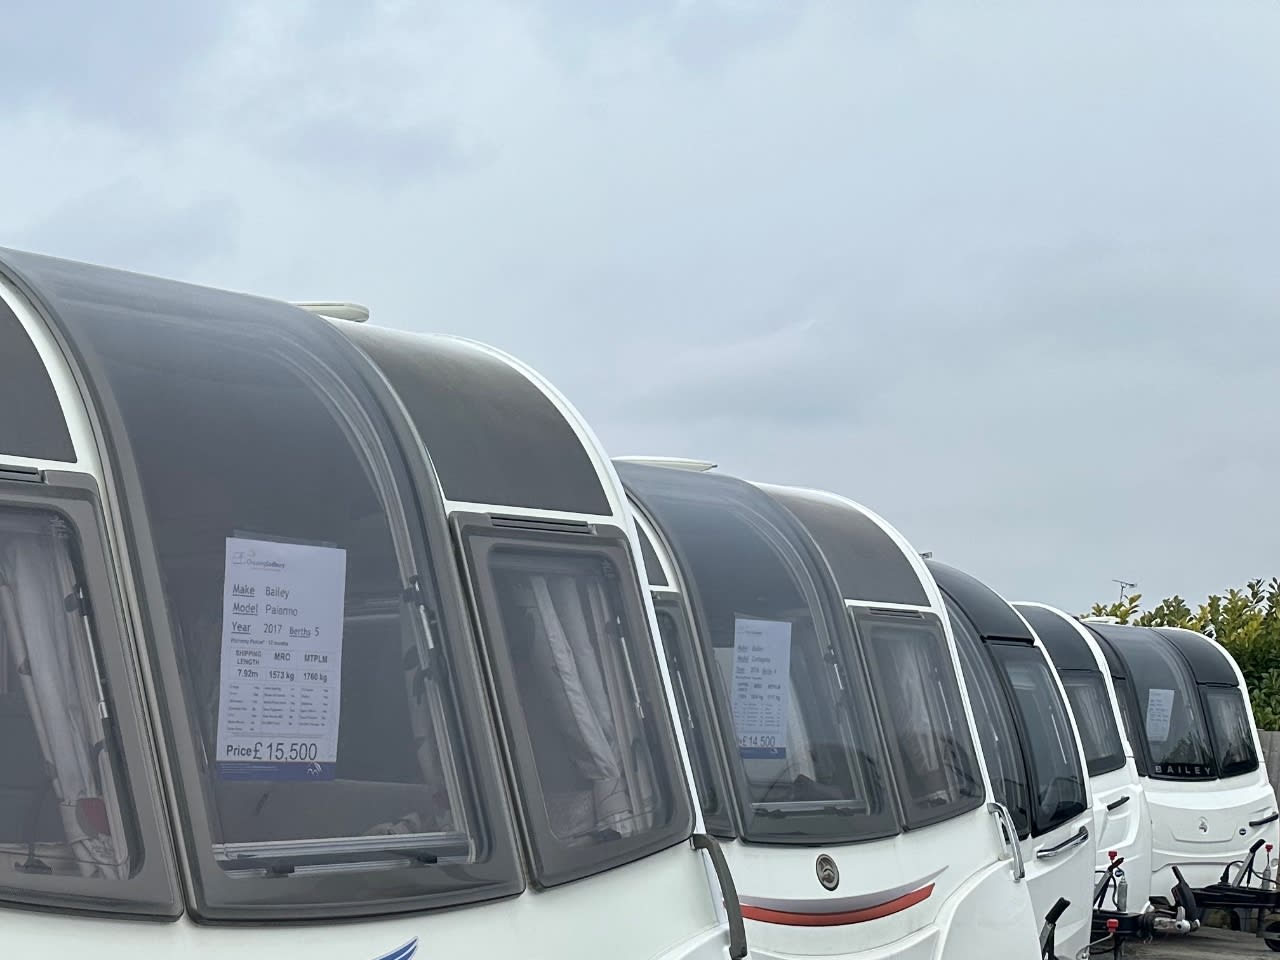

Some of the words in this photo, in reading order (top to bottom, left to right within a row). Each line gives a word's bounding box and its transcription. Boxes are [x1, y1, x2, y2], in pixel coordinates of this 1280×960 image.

[232, 584, 255, 596] Make
[265, 586, 290, 599] Bailey
[232, 603, 258, 614] Model
[232, 621, 251, 632] Year
[263, 623, 282, 633] 2017
[289, 626, 311, 636] Berths
[314, 627, 320, 636] 5
[304, 654, 328, 663] MTPLM
[237, 669, 258, 678] 7.92m
[269, 670, 285, 679] 1573
[286, 671, 295, 681] kg
[226, 744, 252, 756] Price
[1154, 765, 1211, 775] BAILEY
